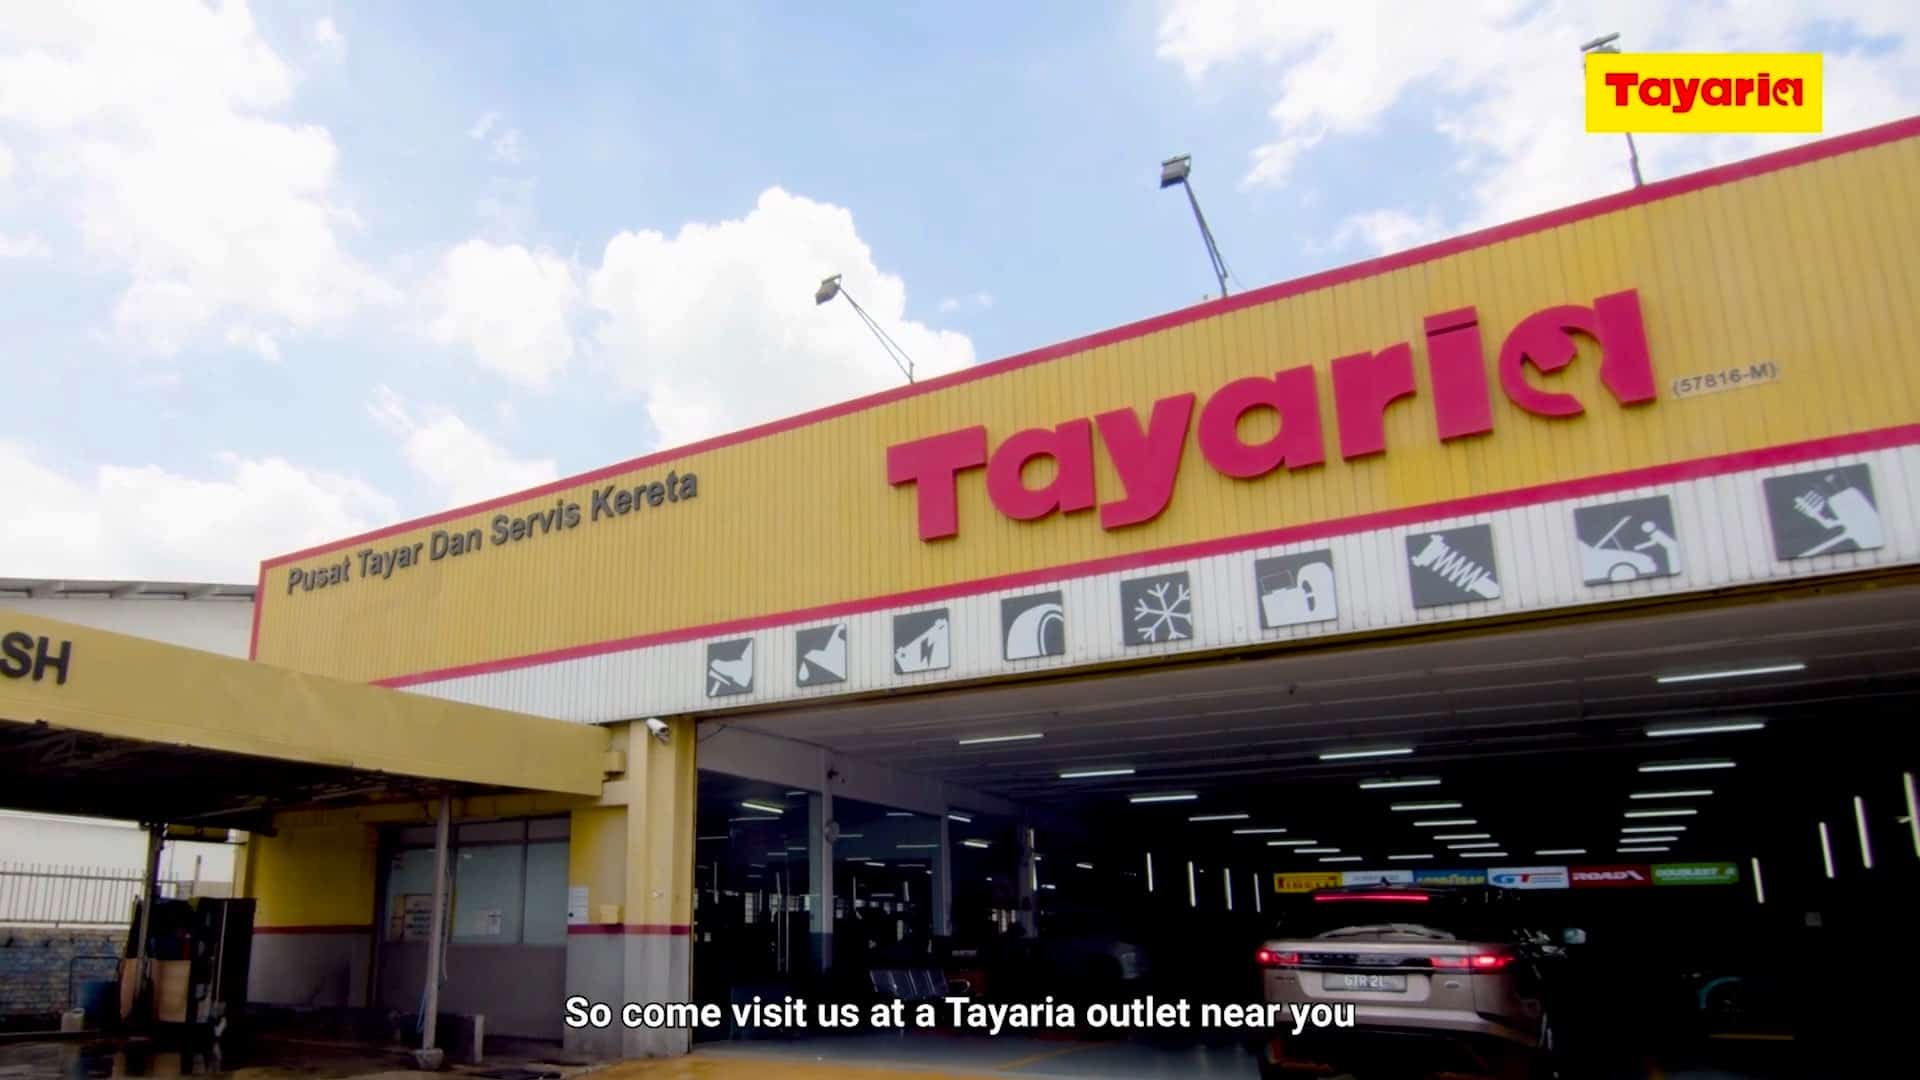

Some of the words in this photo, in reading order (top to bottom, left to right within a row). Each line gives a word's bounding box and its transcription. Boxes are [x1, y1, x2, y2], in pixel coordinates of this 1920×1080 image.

[887, 288, 1657, 541] Tayaria
[1672, 361, 1778, 397] (57816-M)
[287, 555, 350, 595] Pusat
[357, 541, 424, 581] Tayar
[429, 528, 482, 561] Dan
[490, 499, 581, 546] Servis
[591, 470, 699, 522] Kereta
[0, 631, 72, 686] SH
